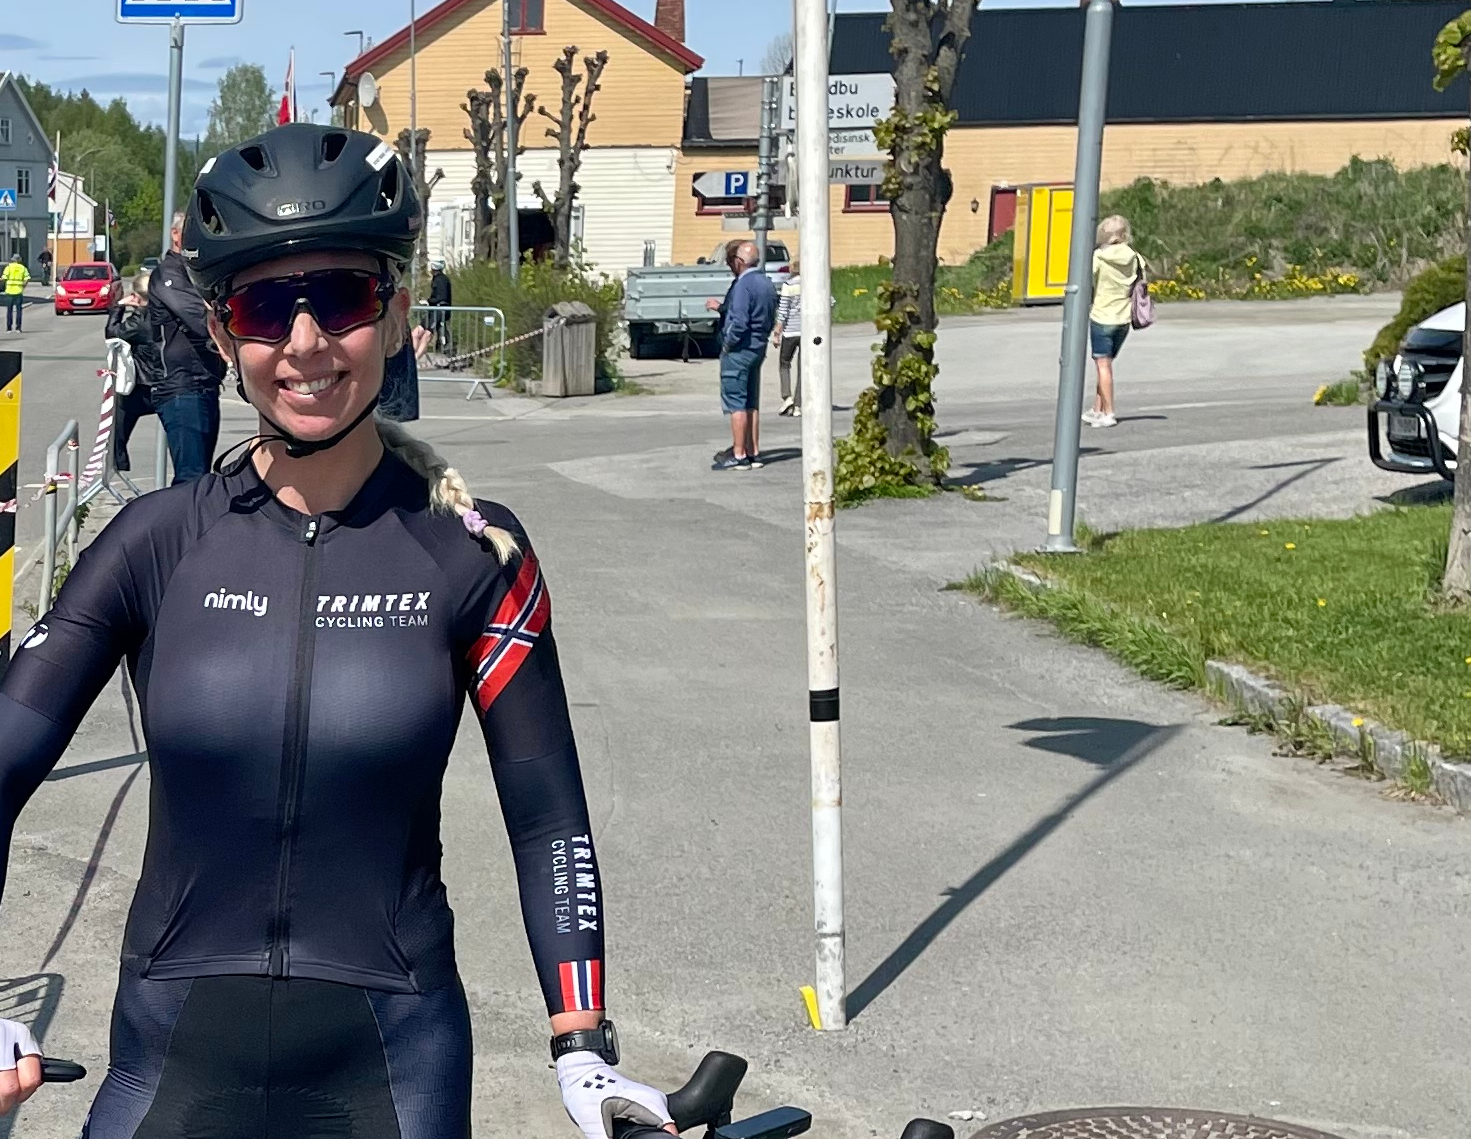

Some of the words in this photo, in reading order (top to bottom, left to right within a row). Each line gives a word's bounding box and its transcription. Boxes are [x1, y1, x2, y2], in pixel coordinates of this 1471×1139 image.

[730, 173, 744, 195] P
[277, 200, 326, 217] GIRO
[204, 588, 268, 617] nimly
[316, 592, 430, 613] TRIMTEX
[315, 616, 384, 628] CYCLING
[389, 614, 429, 627] TEAM
[551, 839, 569, 897] CYCLING
[570, 834, 597, 931] TRIMTEX
[554, 898, 570, 934] TEAM
